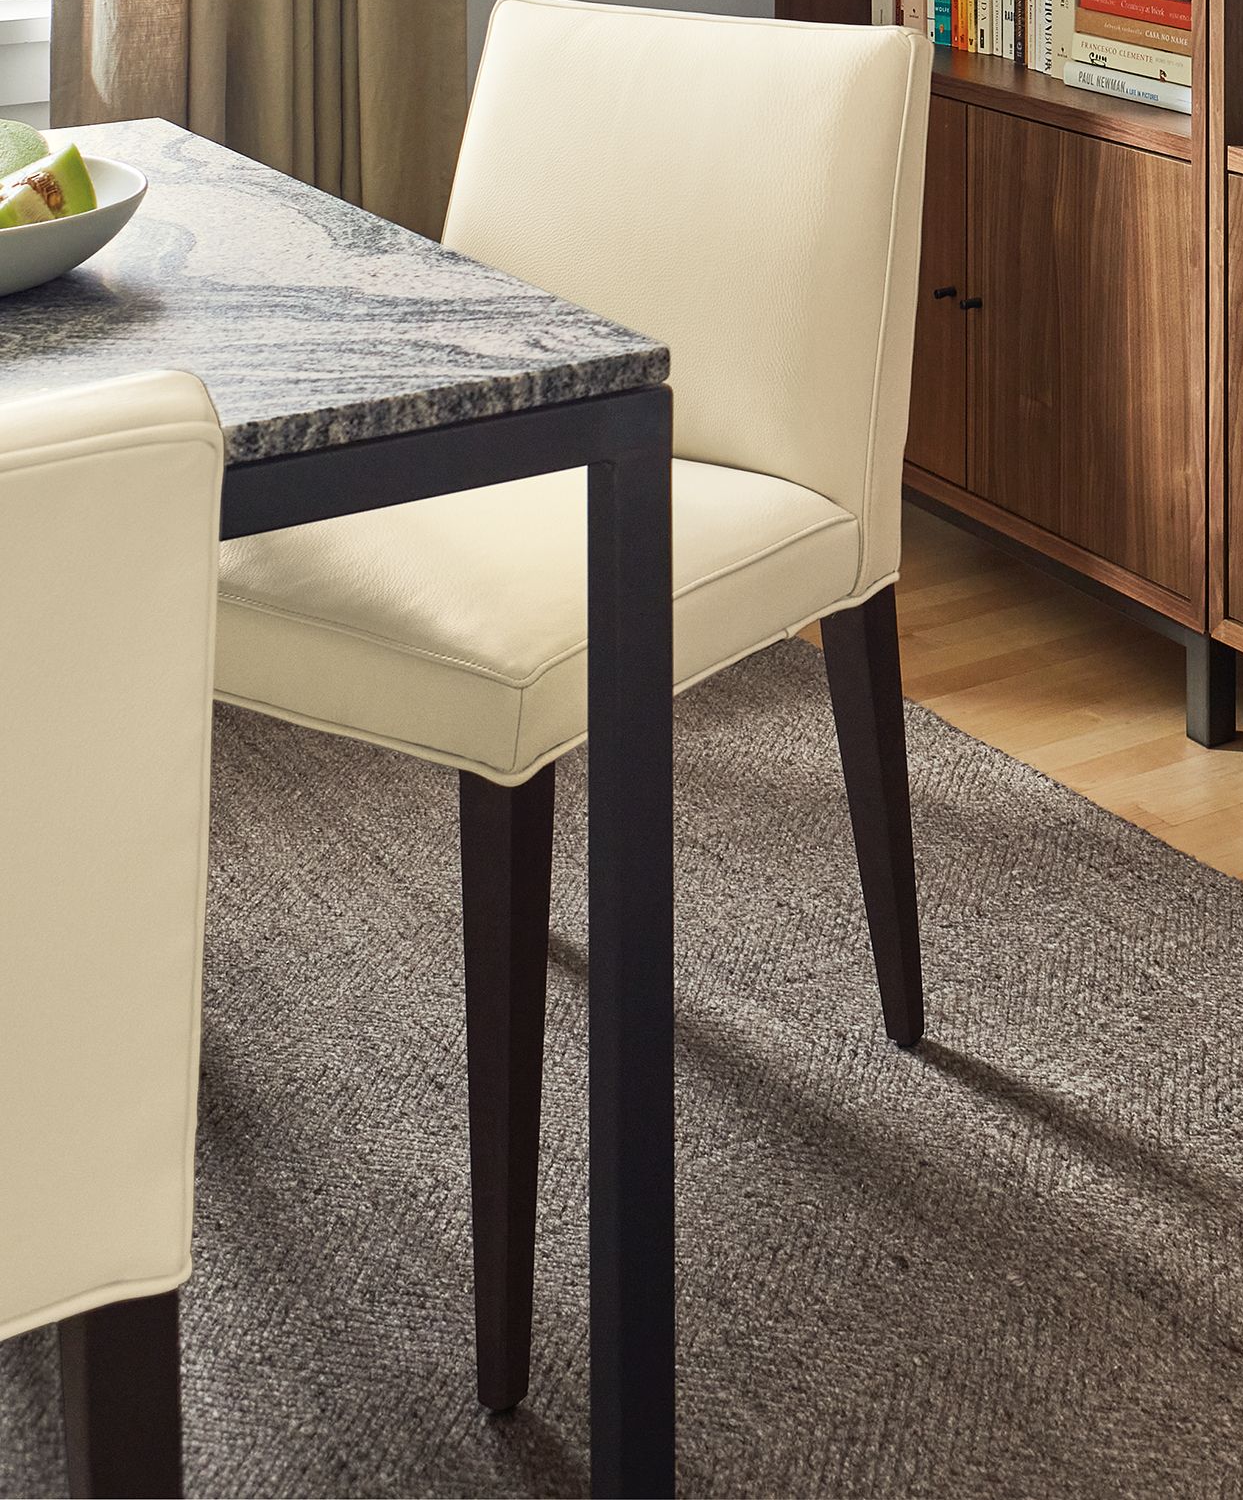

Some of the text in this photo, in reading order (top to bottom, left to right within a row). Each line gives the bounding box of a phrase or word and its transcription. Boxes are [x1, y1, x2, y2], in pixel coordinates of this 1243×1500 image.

[934, 6, 950, 14] WOLFE
[1144, 29, 1188, 46] CASA NO NAME
[1080, 41, 1154, 64] FRANCESCO CLEMENTE
